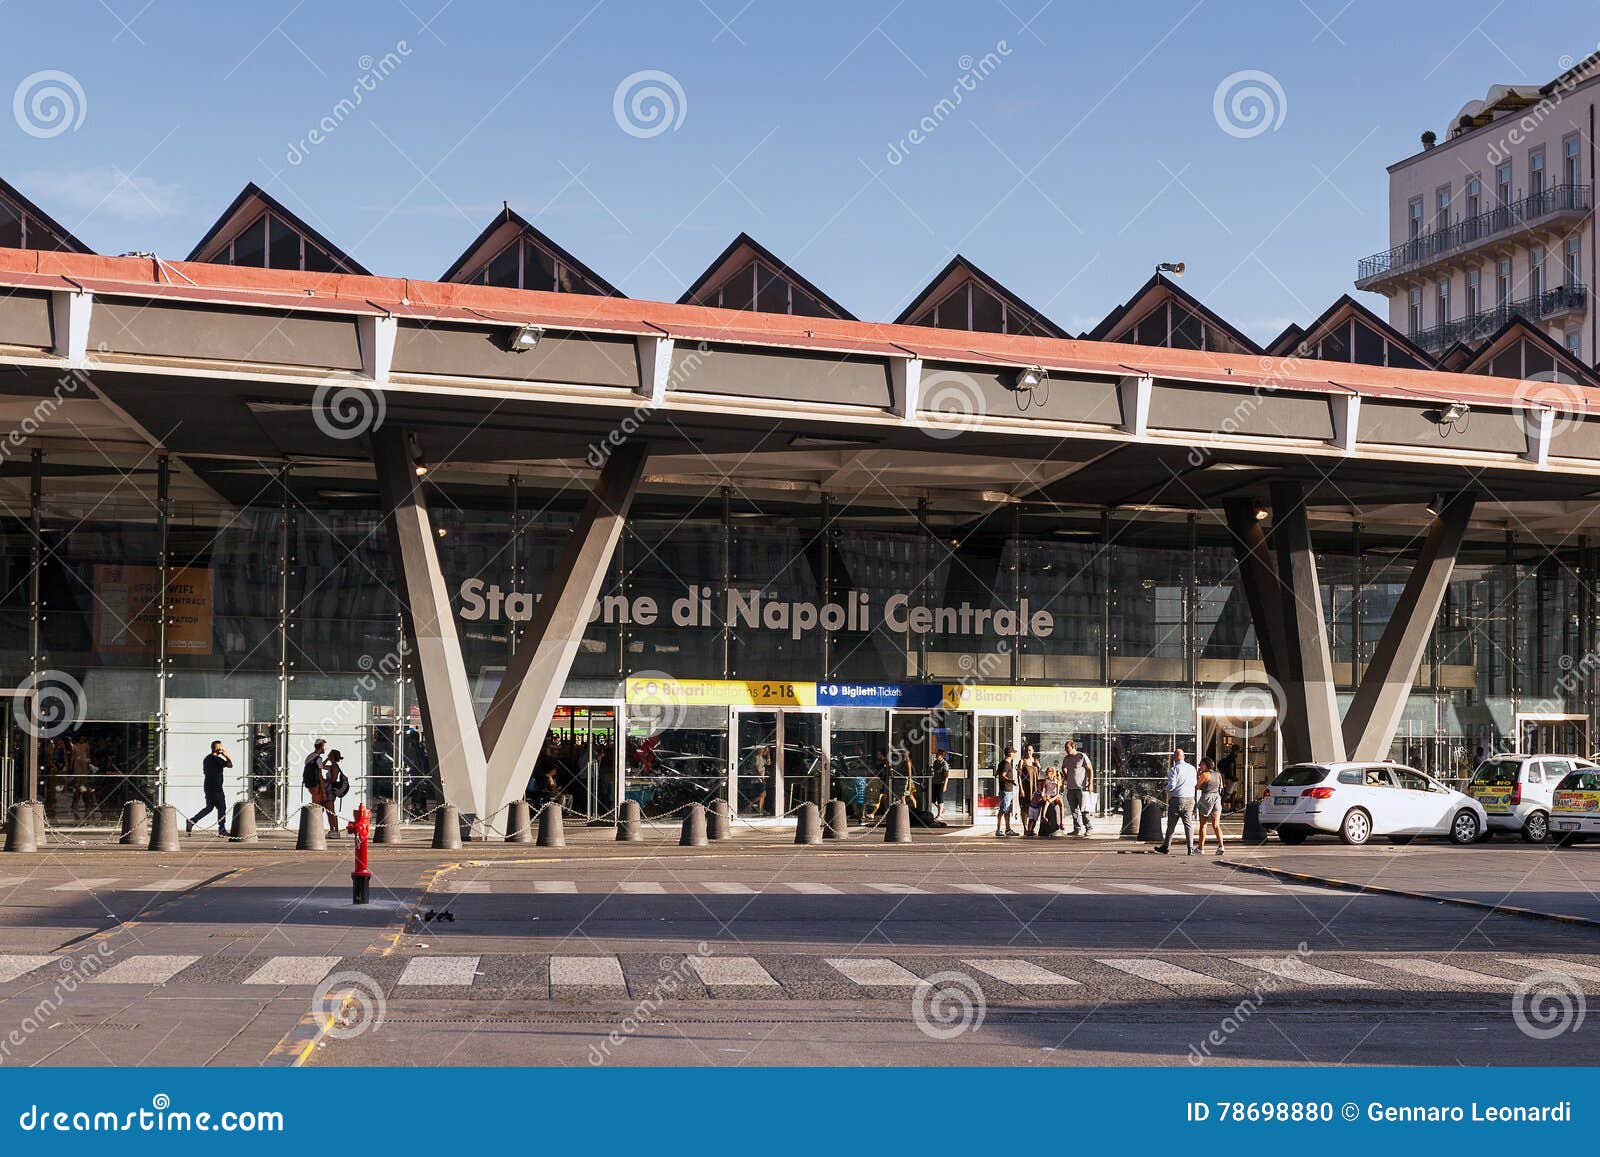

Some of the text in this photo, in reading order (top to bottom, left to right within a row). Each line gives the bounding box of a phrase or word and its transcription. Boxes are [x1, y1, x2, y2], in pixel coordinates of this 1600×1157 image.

[460, 577, 1054, 640] Stane di Napoli Centrale
[663, 682, 704, 697] Binari
[762, 684, 795, 698] 2-18
[841, 685, 903, 699] Biglietti Tickets
[974, 689, 1012, 702] Binari
[1063, 691, 1099, 703] 19-24
